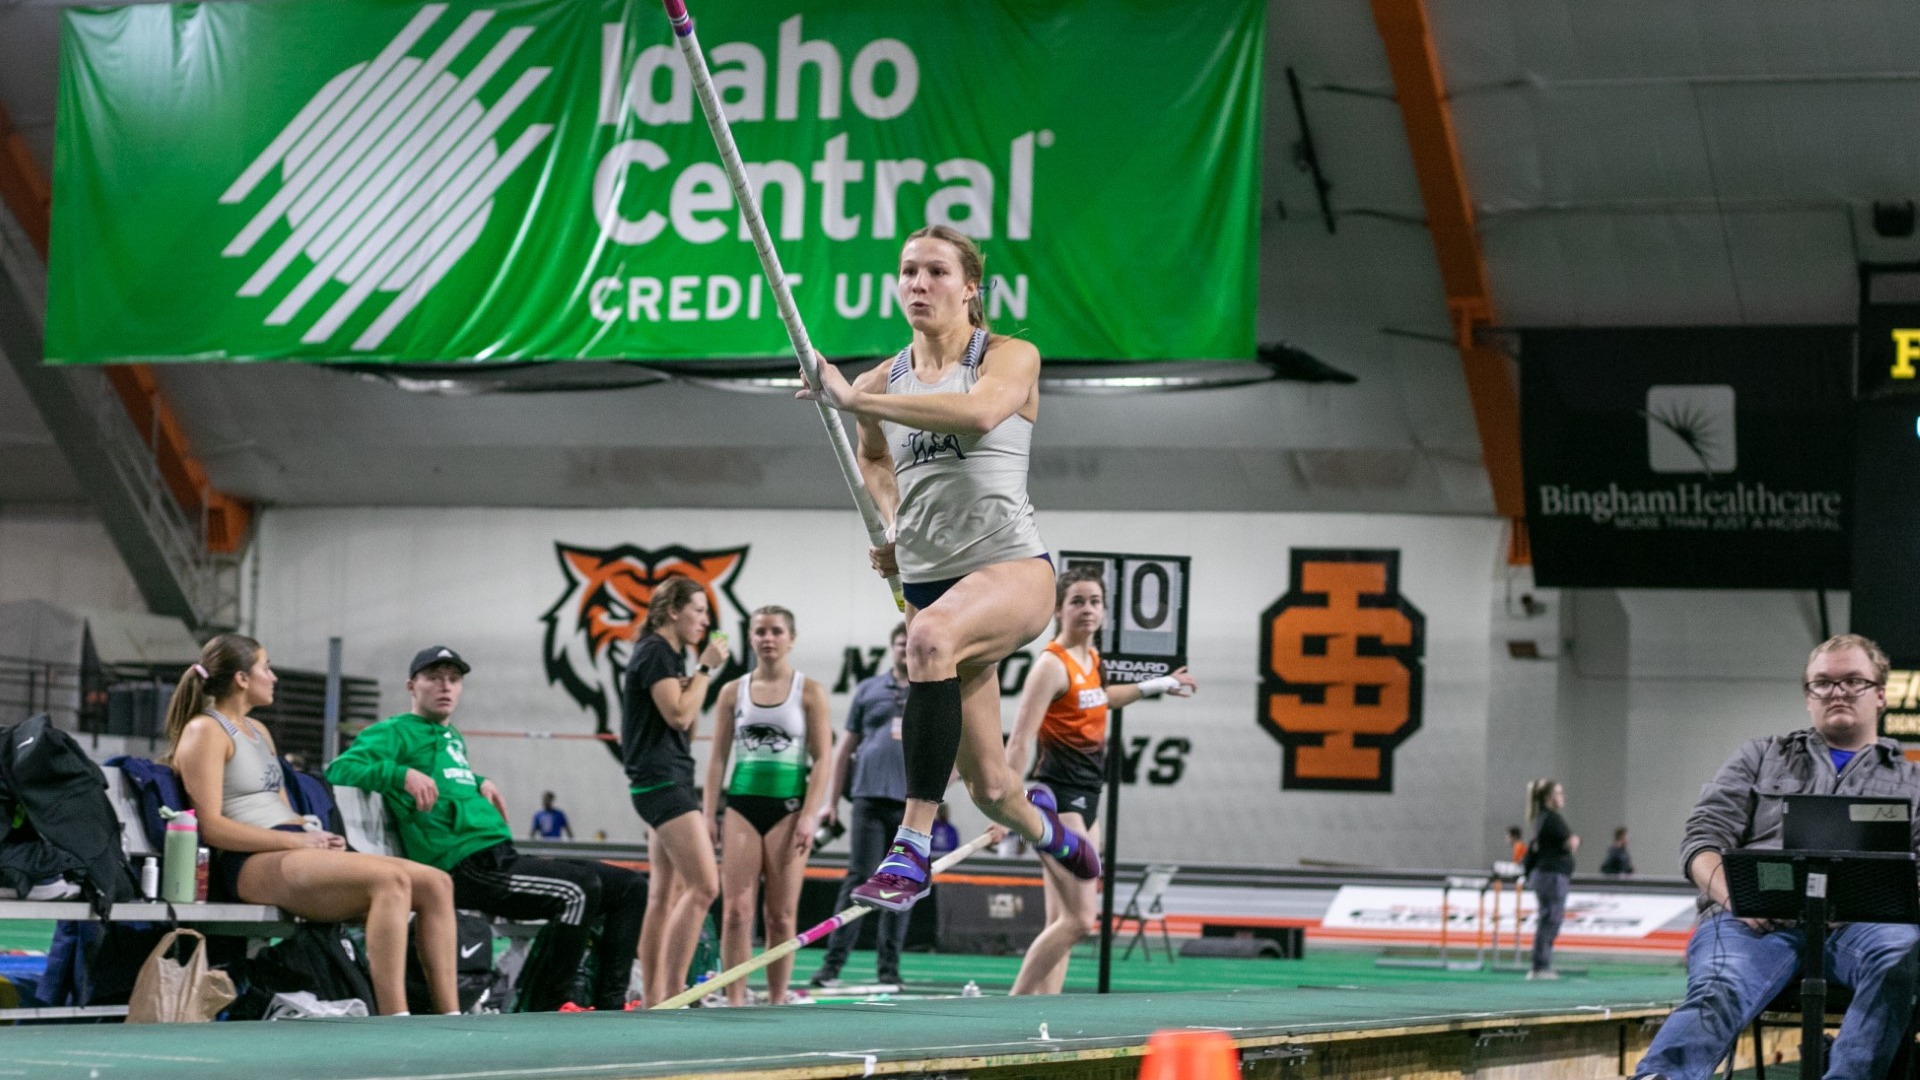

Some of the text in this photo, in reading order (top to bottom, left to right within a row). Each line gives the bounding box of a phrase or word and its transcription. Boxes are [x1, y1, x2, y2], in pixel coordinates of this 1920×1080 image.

[601, 14, 920, 126] Idaho
[834, 272, 1029, 320] UNN
[1614, 517, 1661, 530] MORE
[1666, 517, 1708, 530] THAN
